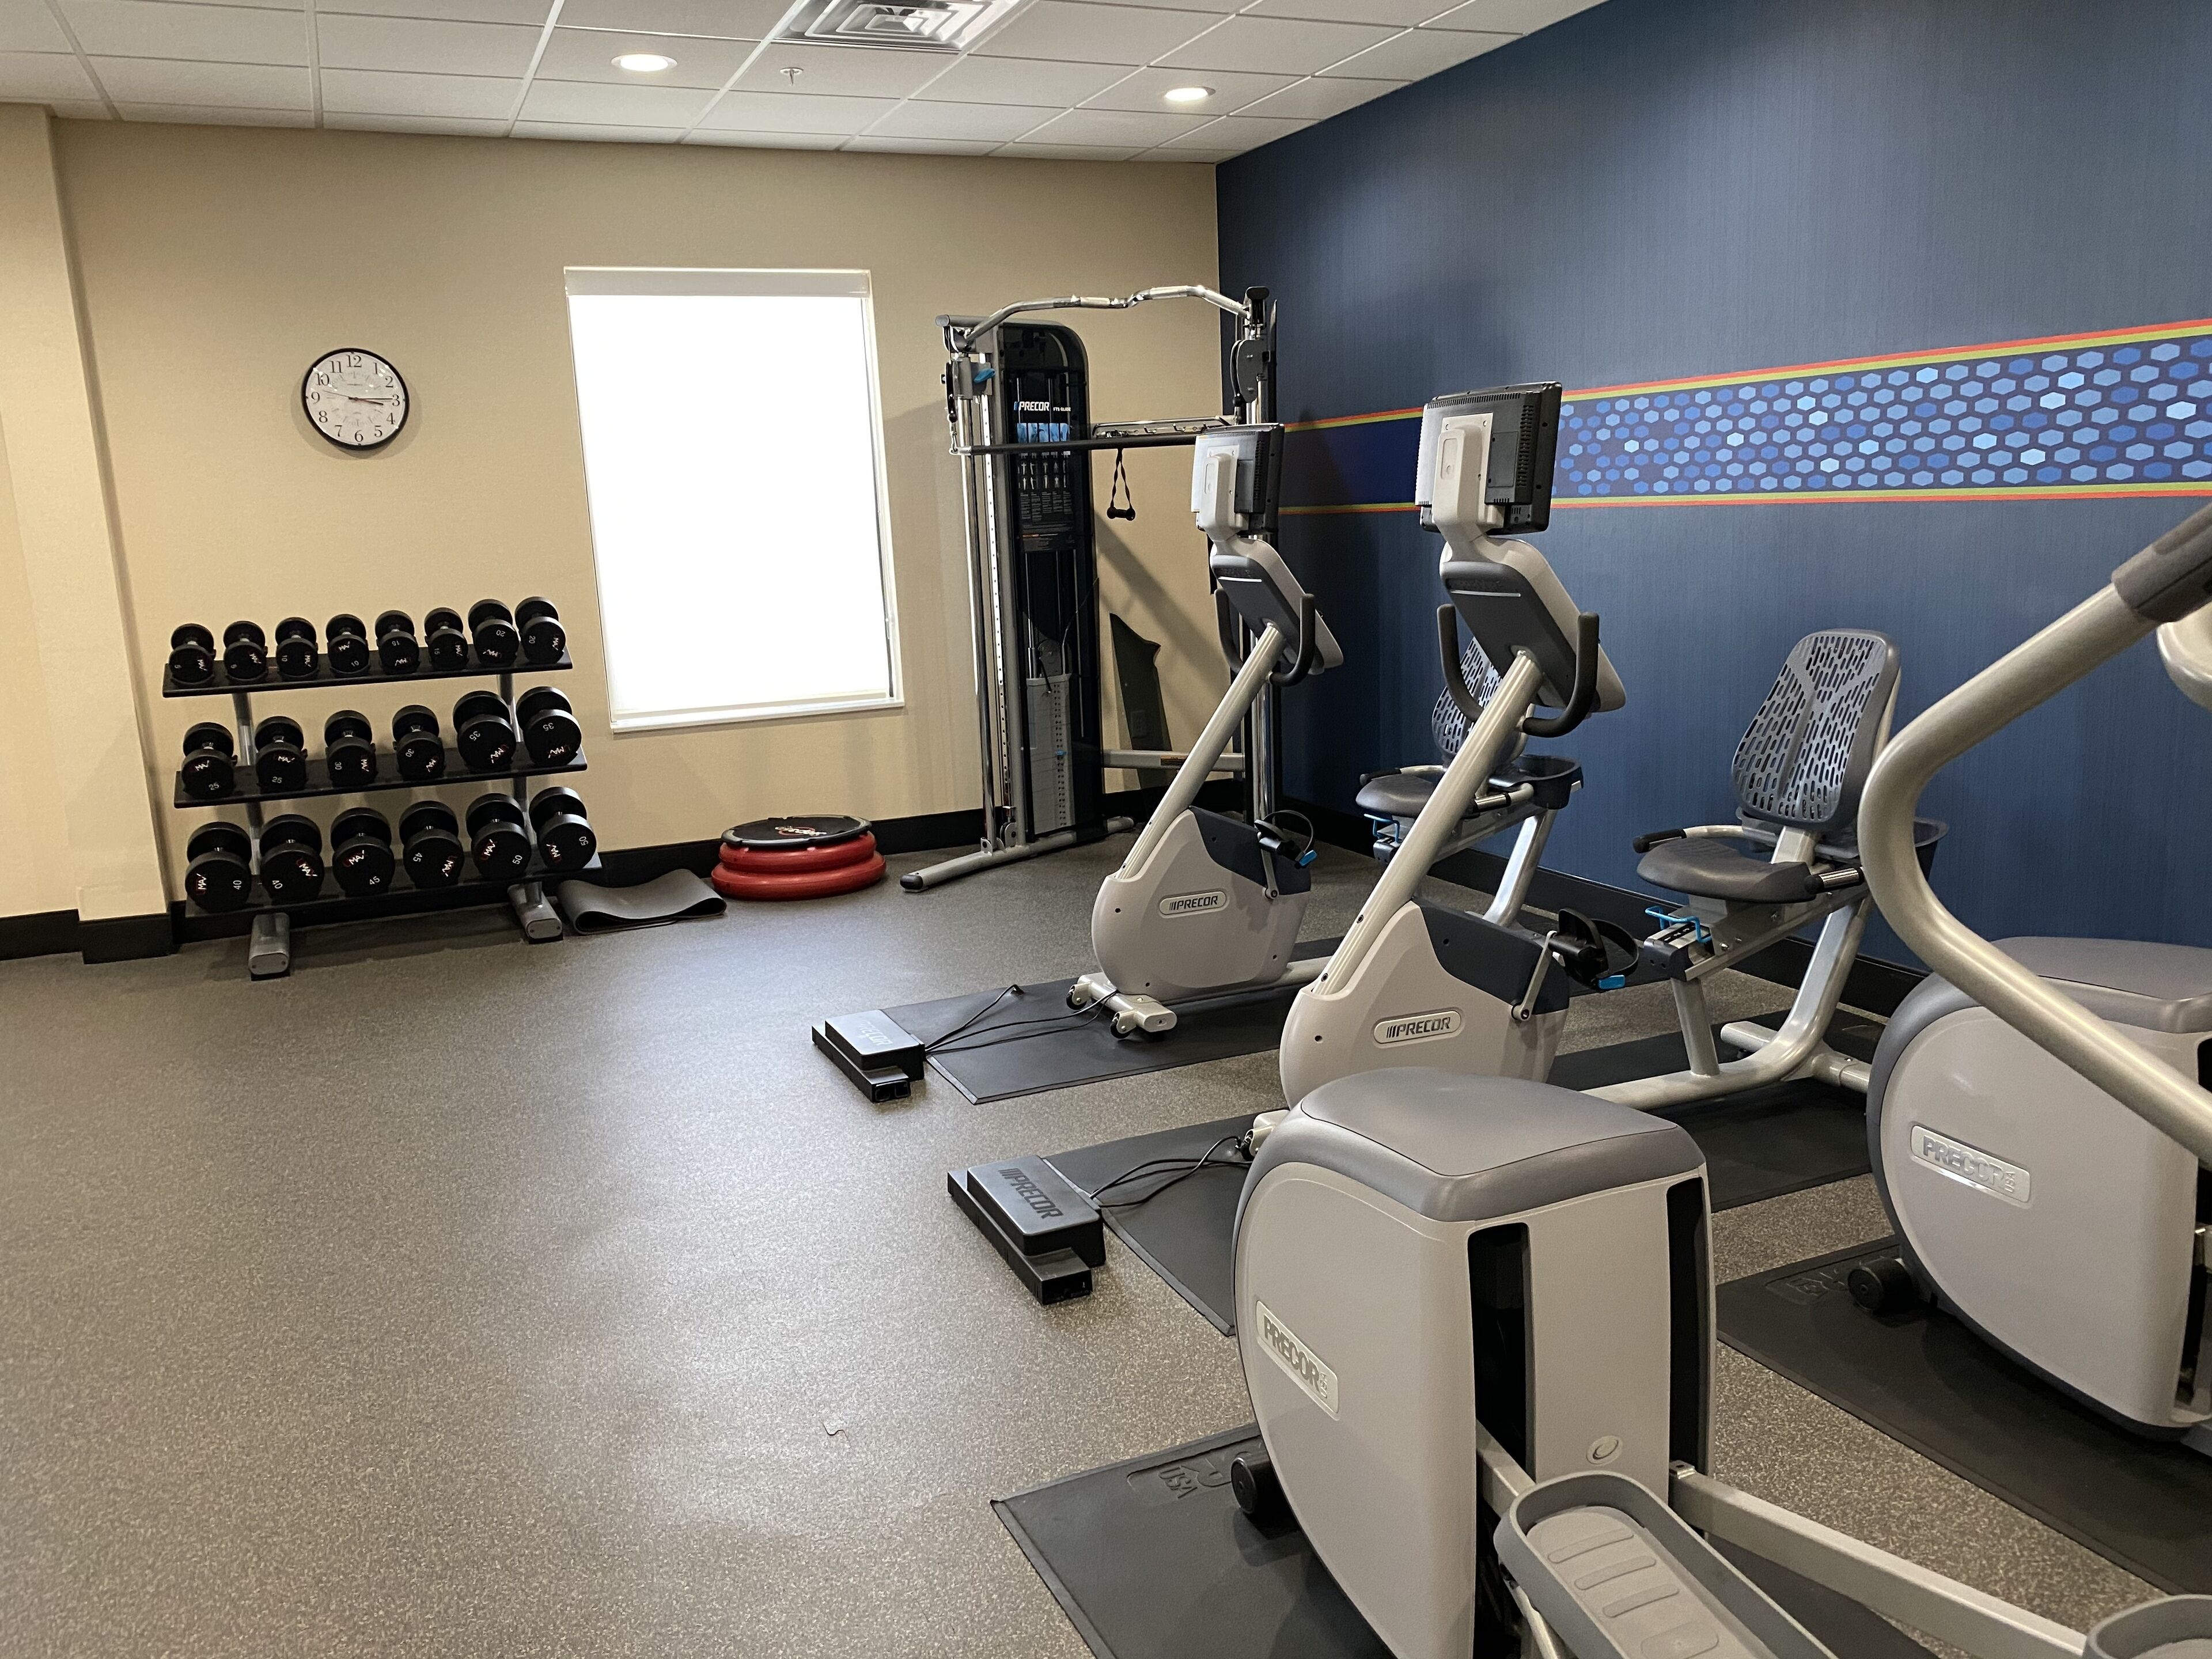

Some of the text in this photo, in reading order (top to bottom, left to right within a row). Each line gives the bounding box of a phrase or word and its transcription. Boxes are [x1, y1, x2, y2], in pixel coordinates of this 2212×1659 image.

[329, 361, 343, 373] 11
[346, 355, 362, 368] 12
[373, 362, 378, 375] 1
[316, 373, 329, 386] 10
[385, 376, 393, 388] 2
[311, 392, 320, 404] 9
[392, 394, 400, 406] 3
[1018, 401, 1050, 411] PRECOR
[319, 410, 328, 423] 8
[387, 412, 395, 425] 4
[334, 425, 342, 437] 7
[354, 430, 363, 442] 6
[374, 425, 382, 437] 5
[528, 635, 536, 644] 20
[543, 722, 554, 732] 35
[469, 730, 480, 741] 35
[405, 748, 414, 757] 30
[334, 762, 342, 770] 30
[209, 782, 219, 790] 25
[578, 836, 589, 846] 50
[412, 852, 423, 862] 45
[512, 855, 523, 865] 50
[233, 880, 242, 890] 40
[272, 880, 283, 889] 40
[369, 876, 380, 885] 45
[1177, 896, 1218, 910] PRECOR
[1396, 1017, 1450, 1037] PRECOR
[1009, 1168, 1064, 1219] PRECOR
[1264, 1313, 1320, 1394] PRECOR
